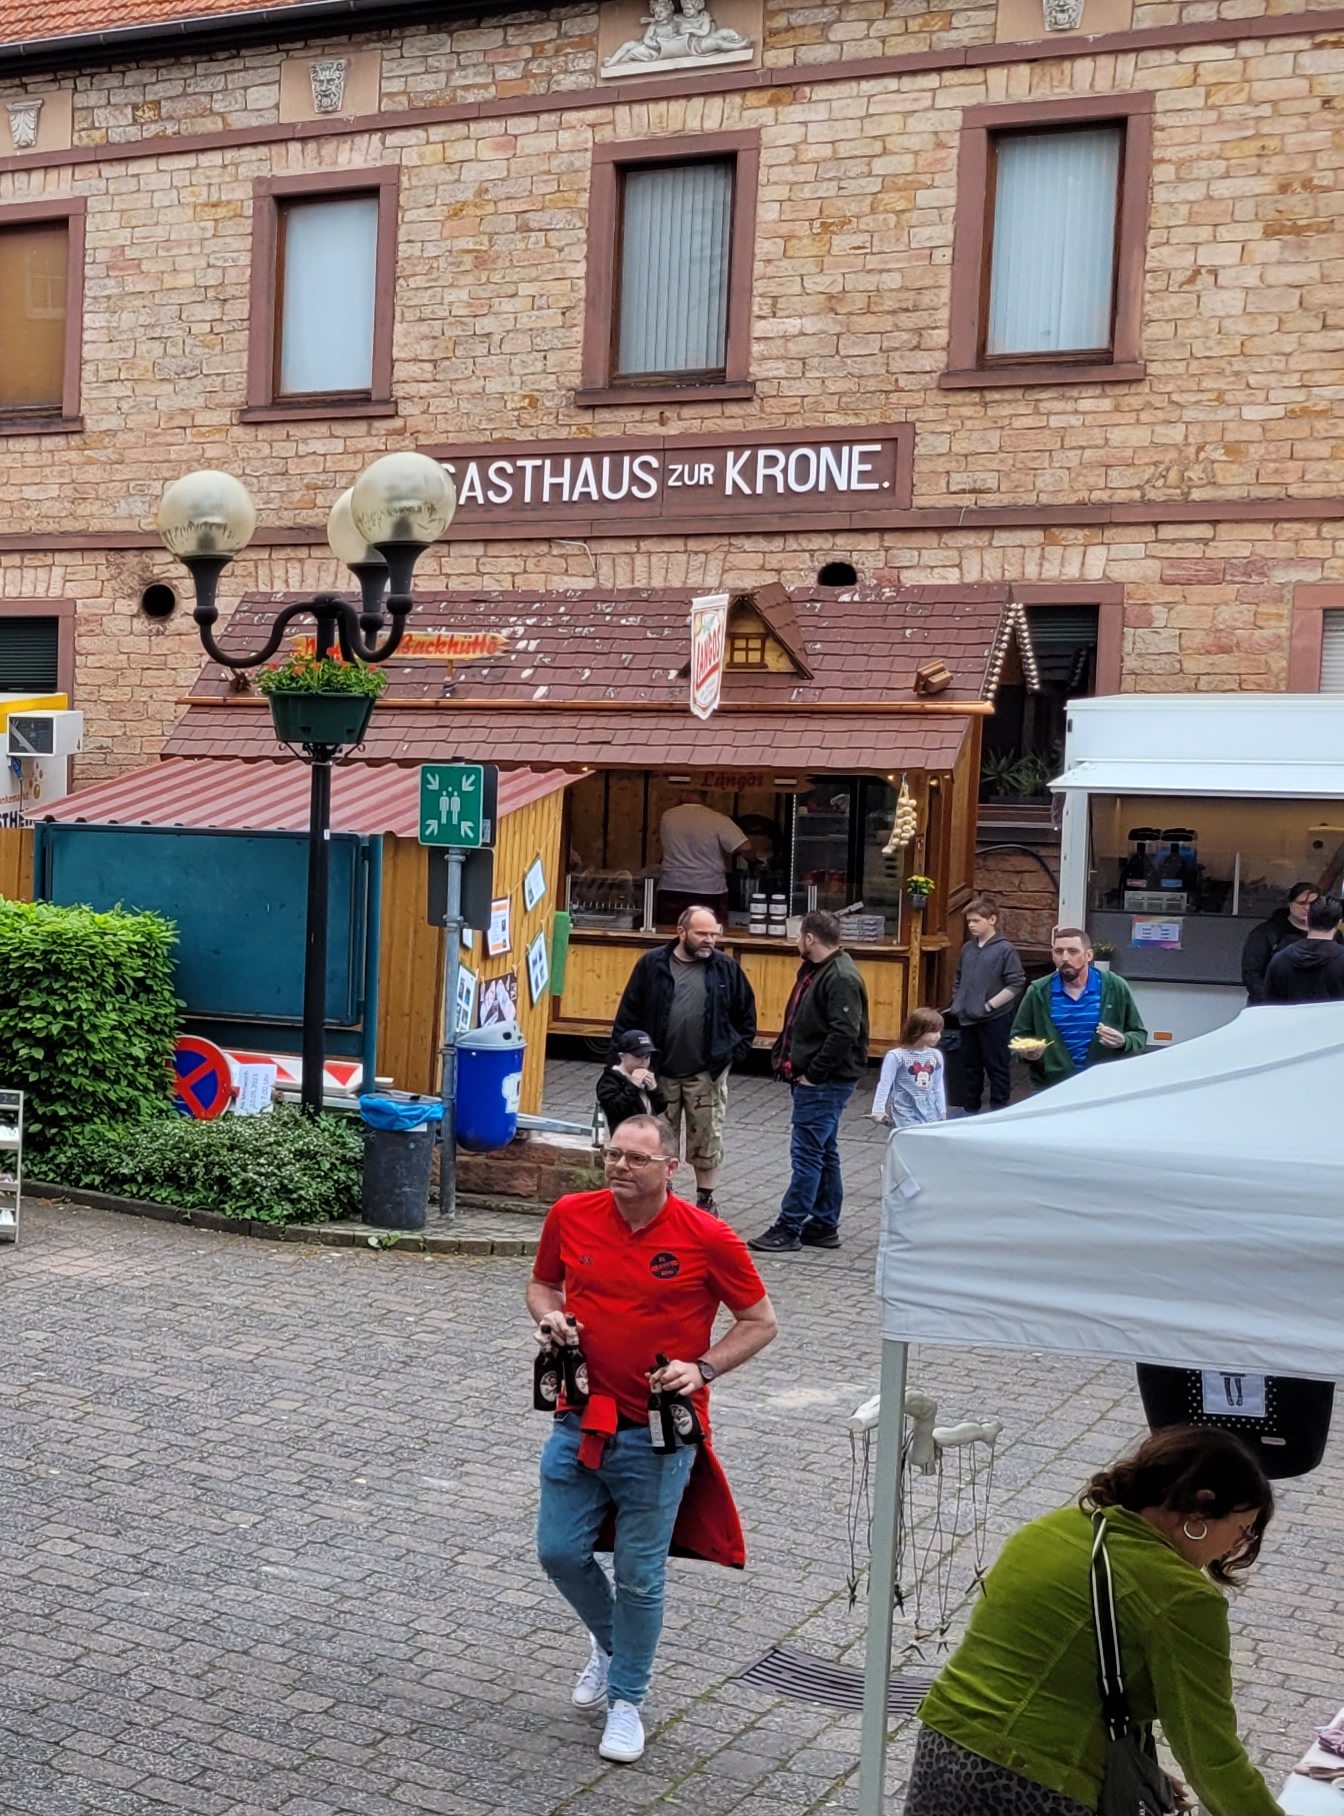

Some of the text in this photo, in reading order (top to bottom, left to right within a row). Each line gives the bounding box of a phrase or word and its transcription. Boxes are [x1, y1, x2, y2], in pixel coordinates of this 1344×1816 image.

[440, 444, 892, 506] ASTHAUS ZUR KRONE.
